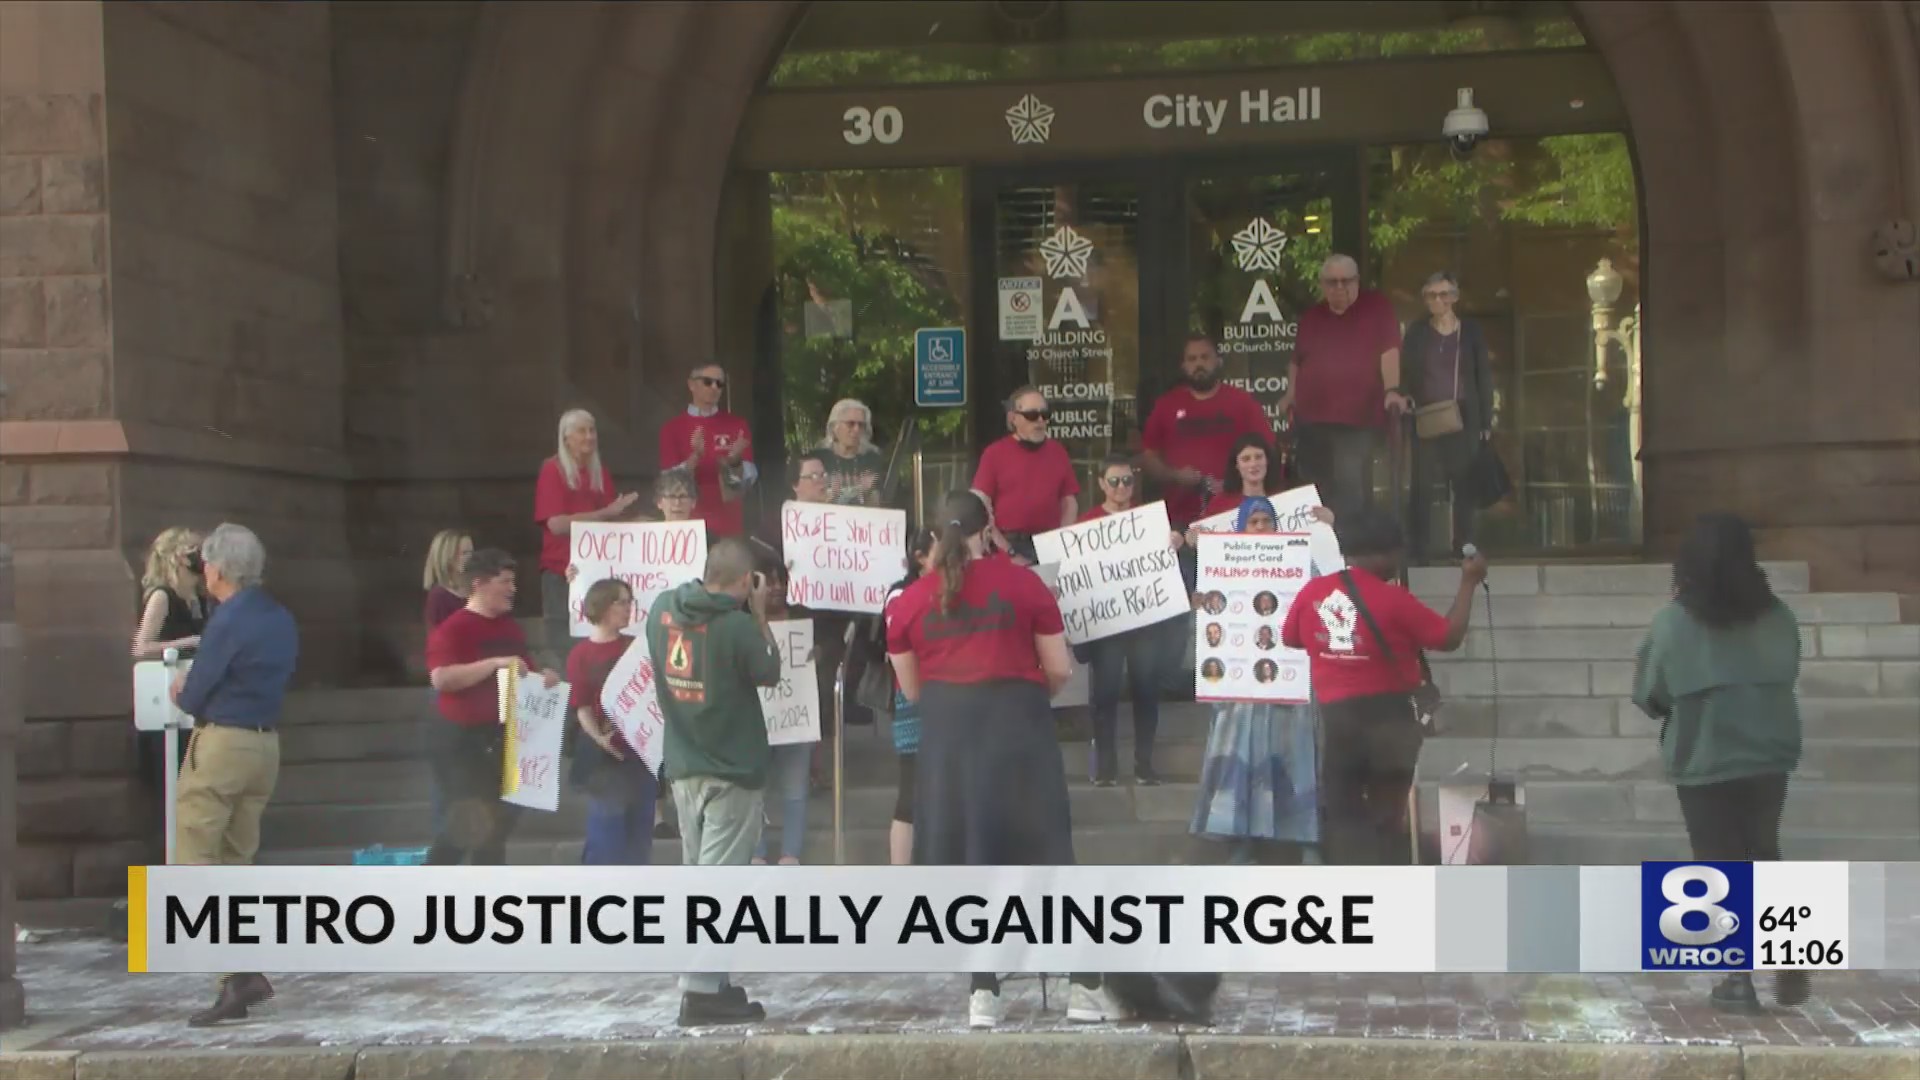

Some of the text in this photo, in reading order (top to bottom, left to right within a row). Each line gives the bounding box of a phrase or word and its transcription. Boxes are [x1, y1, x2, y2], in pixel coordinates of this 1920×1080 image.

[1143, 86, 1321, 135] City Hall
[843, 106, 904, 145] 30
[1047, 286, 1091, 330] A
[1239, 278, 1284, 322] A
[1032, 329, 1106, 347] BUILDING
[1223, 323, 1298, 340] BUILDING
[1026, 346, 1112, 361] 30 Church Street
[1217, 339, 1296, 354] 30 Church Stre
[1038, 382, 1115, 400] ELCOME
[1045, 424, 1113, 439] NTRANCE
[1059, 511, 1146, 559] Protect
[641, 528, 698, 566] 10,000
[1223, 541, 1252, 551] Public
[1254, 542, 1284, 551] Power
[1224, 553, 1283, 564] Report Card
